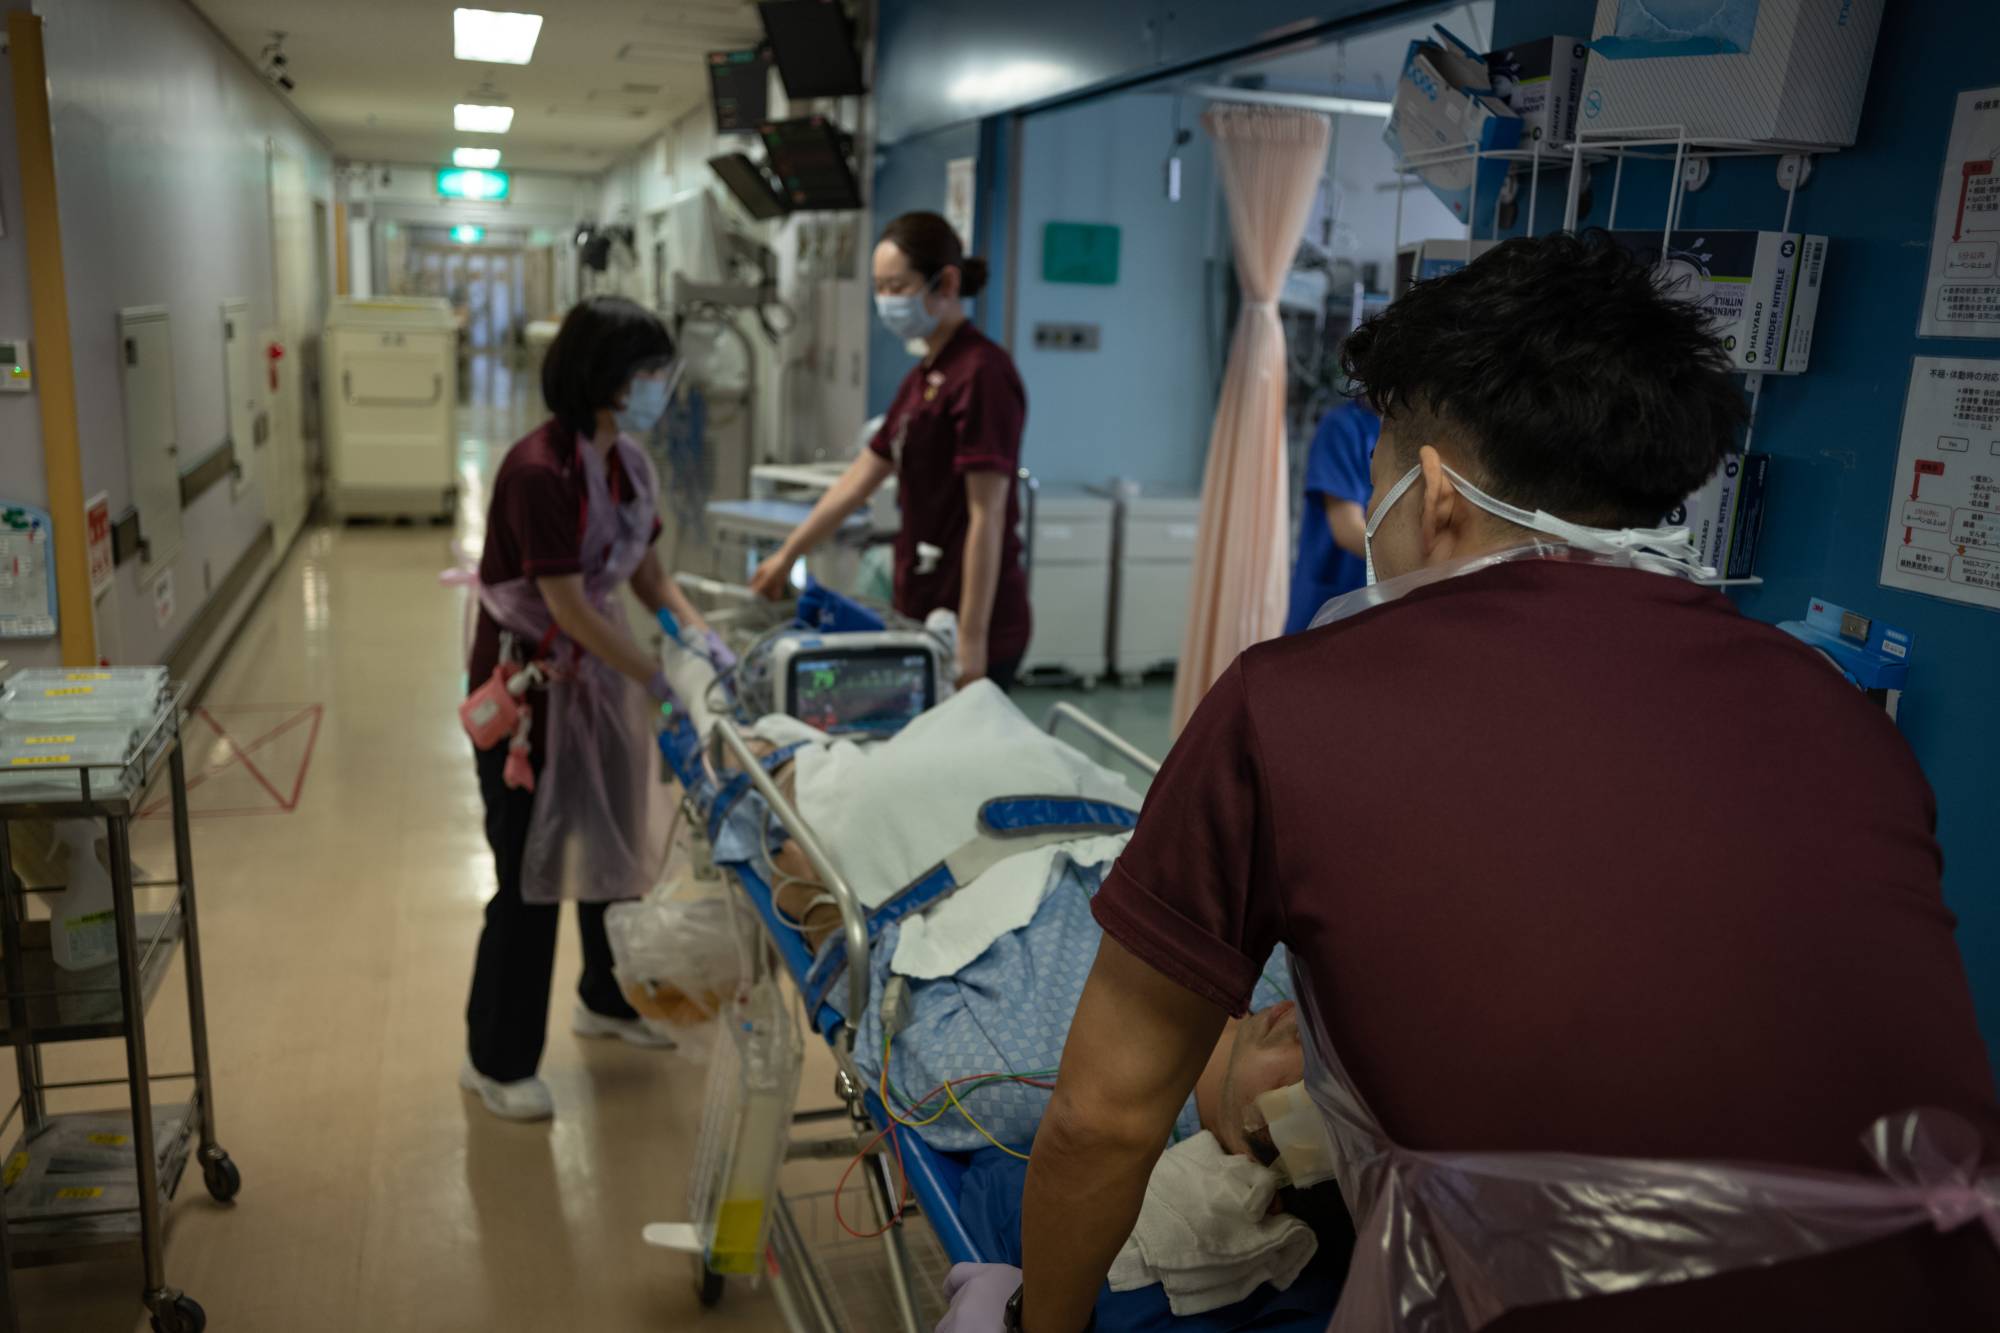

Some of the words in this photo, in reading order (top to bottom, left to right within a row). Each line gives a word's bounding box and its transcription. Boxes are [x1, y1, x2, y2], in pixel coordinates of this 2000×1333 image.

[1750, 302, 1763, 349] HALYARD
[1763, 311, 1778, 364] LAVENDER
[1772, 268, 1786, 308] NITRILE
[1718, 487, 1729, 523] NITRILE
